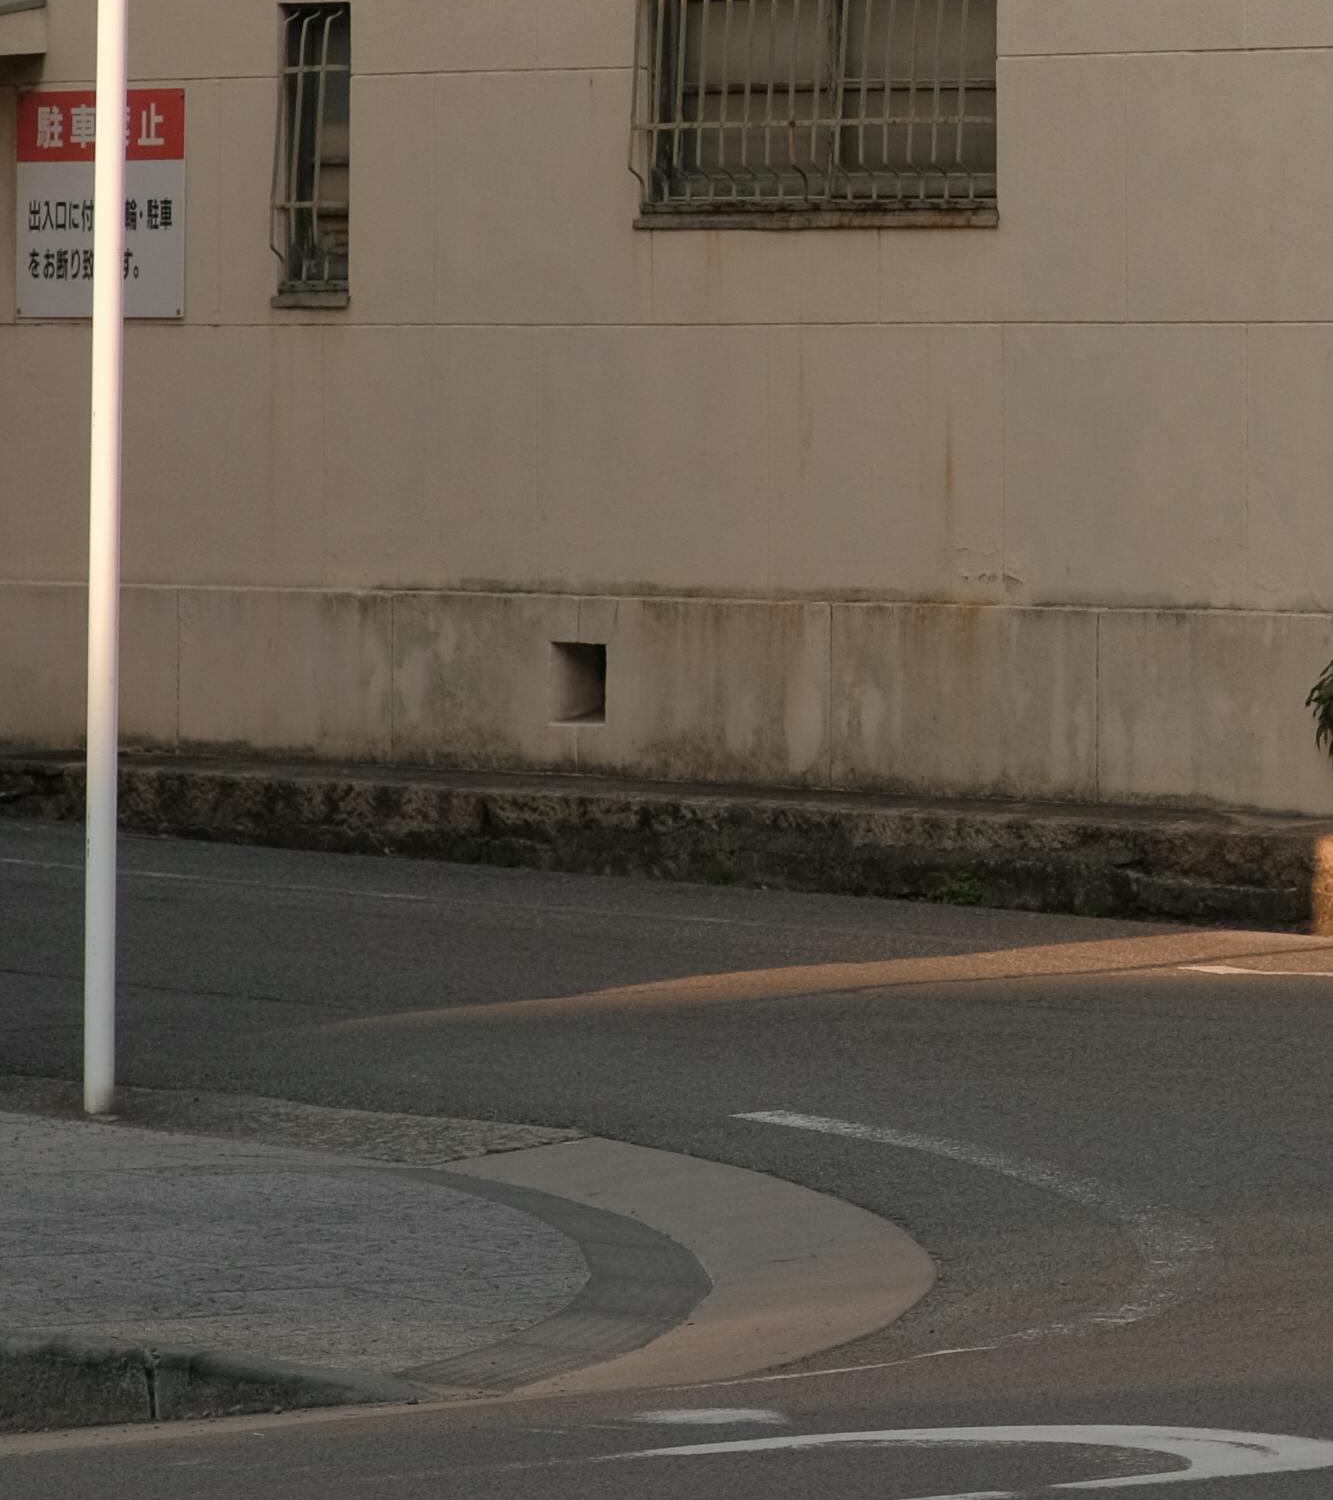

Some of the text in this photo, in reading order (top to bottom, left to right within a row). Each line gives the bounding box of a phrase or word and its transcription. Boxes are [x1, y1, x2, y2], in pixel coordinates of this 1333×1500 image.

[36, 102, 165, 149] 駐車止
[28, 197, 173, 232] 出入口に付輪・駐車
[28, 248, 139, 281] をお断り致す。
